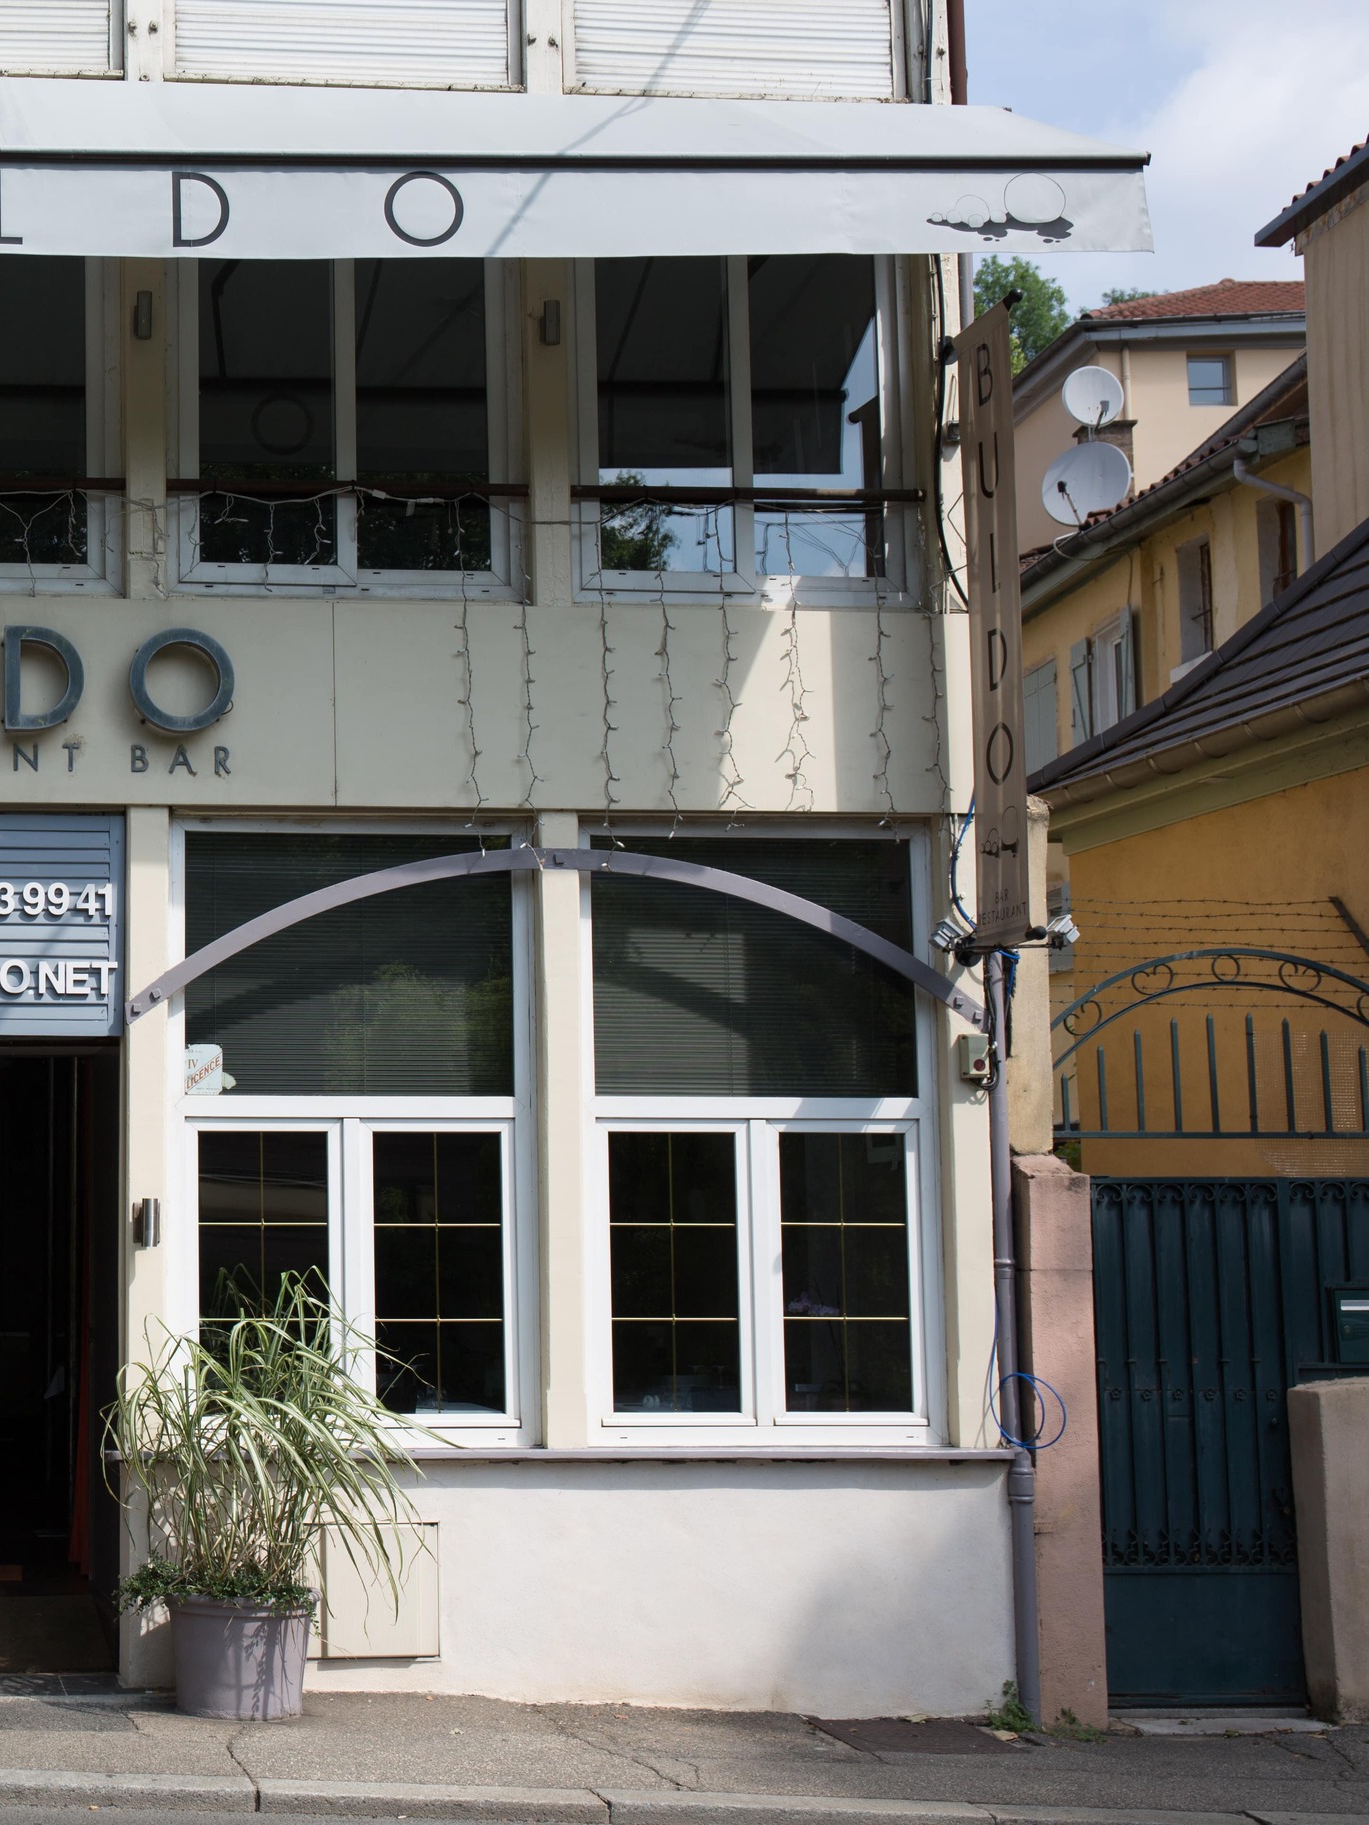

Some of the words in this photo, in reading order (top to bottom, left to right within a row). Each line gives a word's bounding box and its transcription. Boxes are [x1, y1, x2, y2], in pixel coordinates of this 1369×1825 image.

[975, 343, 1015, 786] BULDO
[131, 743, 231, 777] BAR
[186, 1055, 221, 1090] LICENCE
